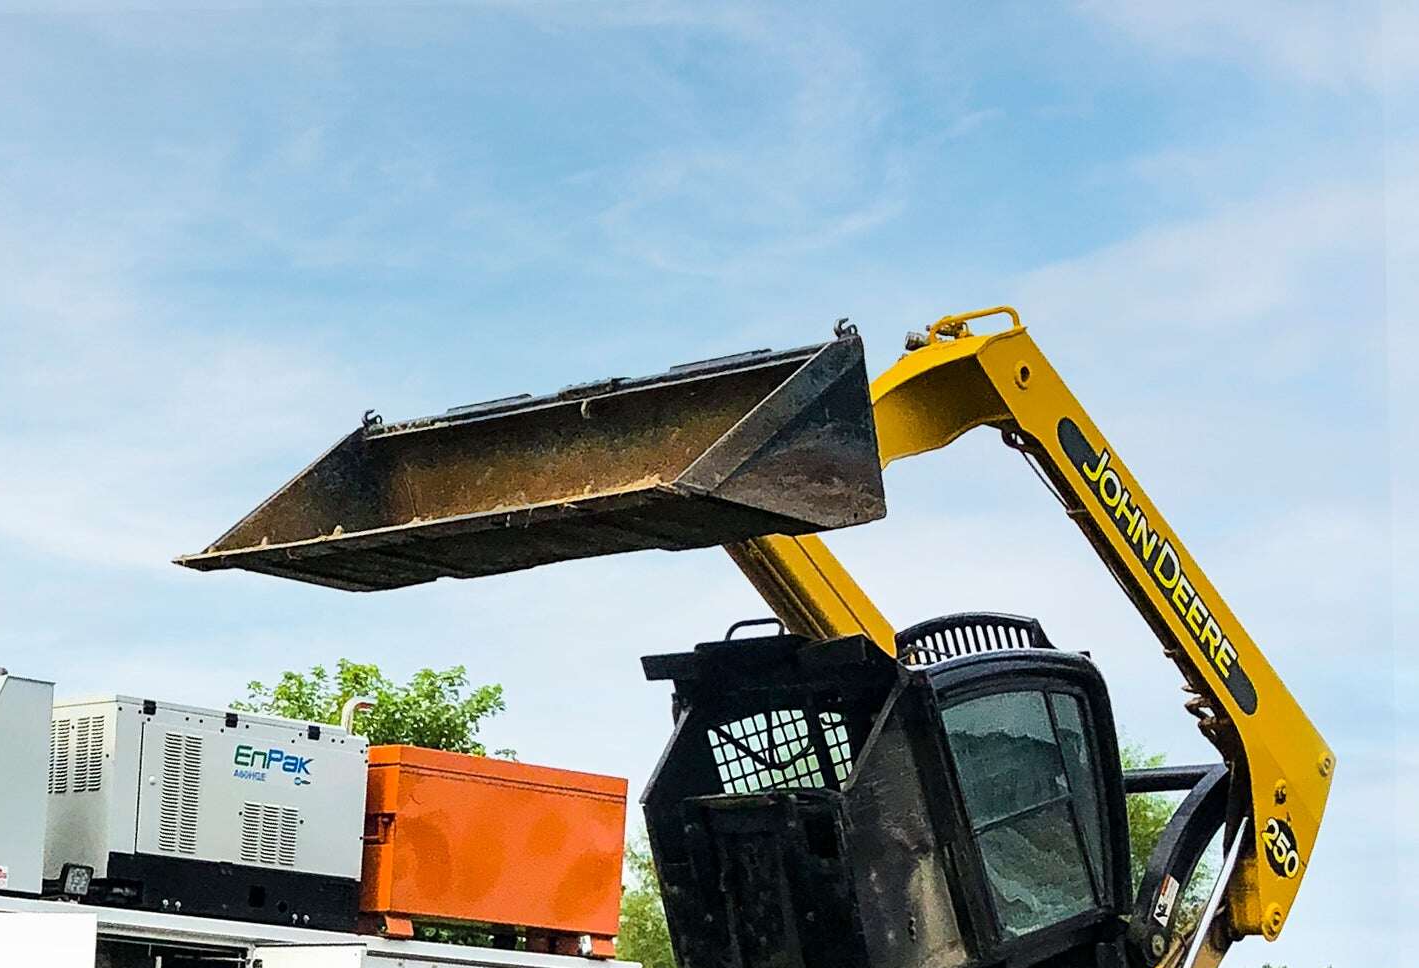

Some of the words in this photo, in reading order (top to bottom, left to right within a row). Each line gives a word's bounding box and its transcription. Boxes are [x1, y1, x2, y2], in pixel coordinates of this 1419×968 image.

[1082, 450, 1158, 562] JOHN
[1153, 539, 1238, 678] DEERE
[234, 744, 315, 775] EnPak
[1261, 817, 1300, 879] 250
